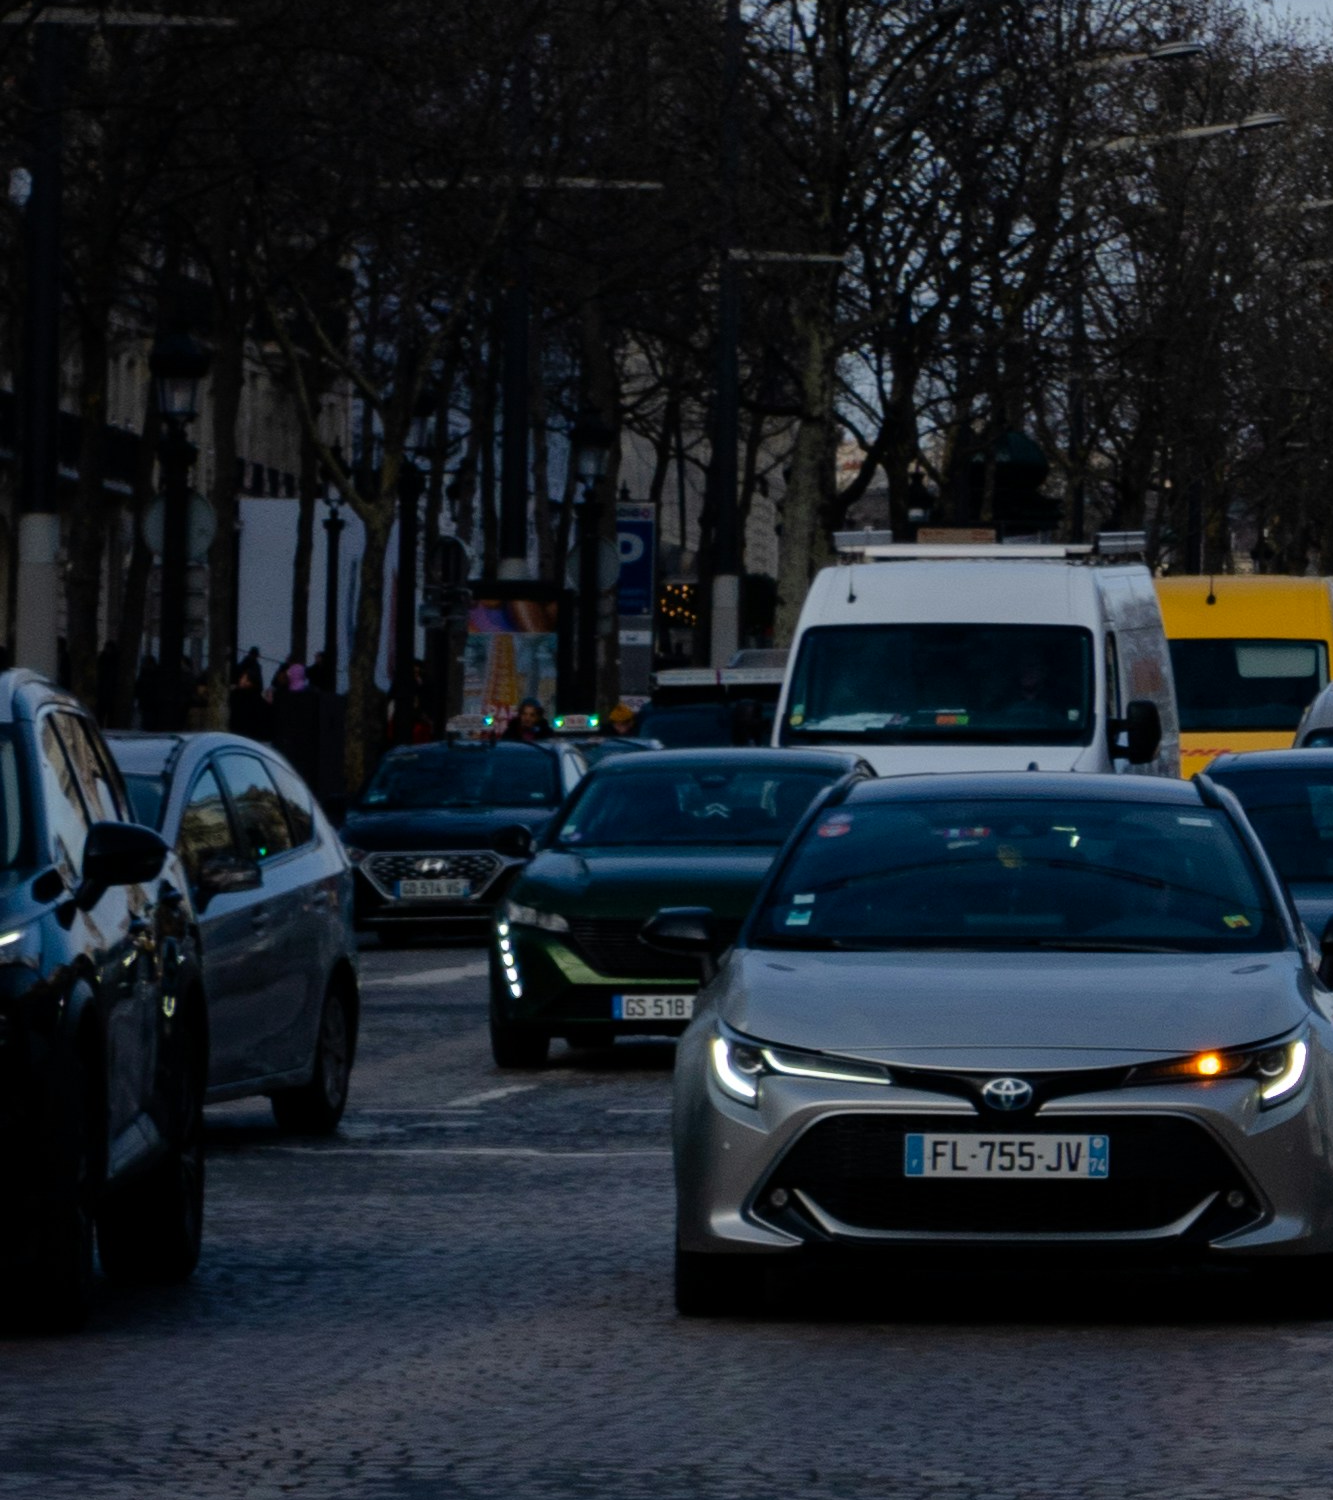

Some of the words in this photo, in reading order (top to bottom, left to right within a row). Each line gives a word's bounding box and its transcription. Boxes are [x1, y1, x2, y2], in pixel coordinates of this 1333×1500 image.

[618, 532, 645, 564] P
[931, 1141, 1082, 1172] FL-755-JV
[1089, 1157, 1106, 1173] 74
